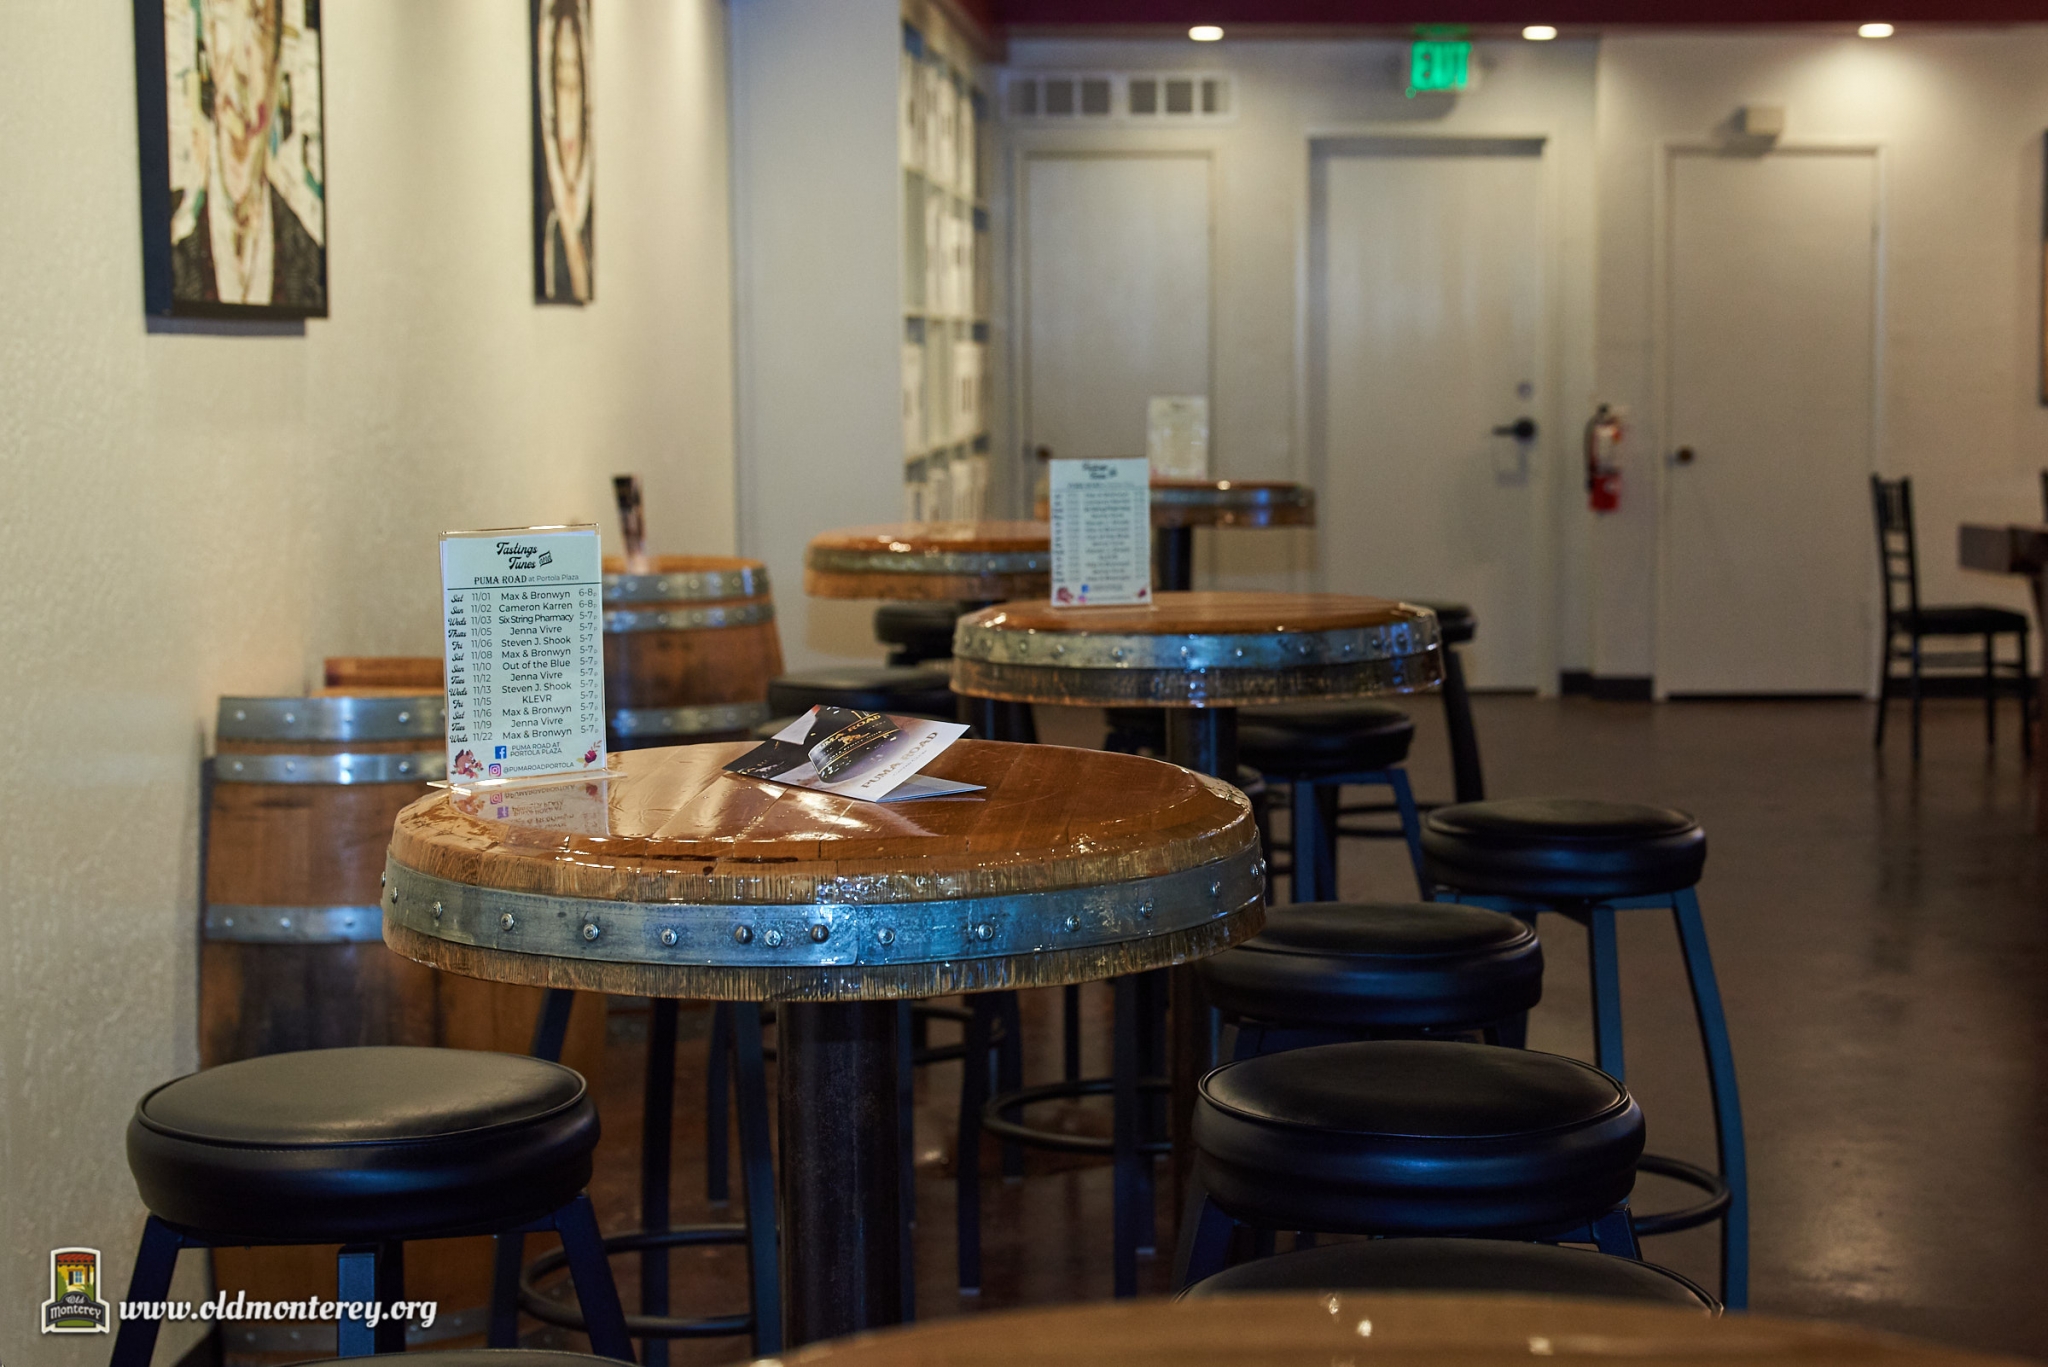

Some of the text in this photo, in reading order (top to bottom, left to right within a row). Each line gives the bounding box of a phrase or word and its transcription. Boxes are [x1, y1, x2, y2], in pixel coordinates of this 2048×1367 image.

[1411, 41, 1471, 90] EXIT
[496, 542, 538, 558] Tastings
[508, 556, 536, 570] Tunes
[474, 576, 500, 585] PUMA
[502, 575, 527, 584] ROAD
[536, 574, 560, 582] Portola
[561, 573, 580, 581] Plaza
[451, 594, 464, 603] Sat
[472, 592, 491, 602] 11/01
[501, 592, 522, 601] Max
[522, 592, 529, 600] &
[531, 590, 571, 600] Bronwyn
[450, 606, 464, 615] Sun
[471, 603, 492, 613] 11/02
[499, 603, 541, 613] Cameron
[543, 601, 573, 611] Karren
[448, 617, 467, 626] Weds
[471, 615, 492, 625] 11/03
[499, 616, 510, 624] Six
[510, 615, 533, 625] String
[534, 613, 574, 623] Pharmacy
[471, 627, 492, 637] 11/05
[510, 627, 538, 636] Jenna
[539, 625, 563, 634] Vivre
[451, 633, 593, 651] Fri 11/06 Steven J. Shook 5-7
[452, 653, 464, 662] Sat
[471, 650, 493, 660] 11/08
[501, 650, 521, 659] Max
[522, 650, 529, 658] &
[531, 648, 571, 658] Bronwyn
[451, 665, 465, 673] Sun
[472, 662, 492, 672] 11/10
[502, 661, 520, 671] Out
[522, 660, 532, 669] of
[533, 660, 548, 669] the
[550, 659, 571, 668] Blue
[451, 676, 465, 685] Tues
[473, 674, 491, 683] 11/12
[510, 673, 538, 682] Jenna
[539, 671, 563, 680] Vivre
[448, 687, 467, 696] Weds
[473, 685, 491, 695] 11/13
[501, 685, 533, 694] Steven
[534, 683, 542, 692] J.
[544, 682, 572, 691] Shook
[452, 699, 464, 709] Fri
[473, 697, 492, 707] 11/15
[522, 695, 553, 704] KLEVR
[452, 711, 465, 720] Sat
[473, 709, 492, 718] 11/16
[502, 708, 522, 717] Max
[523, 707, 530, 716] &
[531, 705, 572, 715] Bronwyn
[451, 722, 465, 731] Tues
[473, 720, 492, 730] 11/19
[511, 719, 538, 728] Jenna
[540, 717, 563, 726] Vivre
[449, 734, 468, 743] Weds
[472, 732, 493, 742] 11/22
[502, 731, 522, 740] Max
[523, 730, 530, 739] &
[532, 728, 573, 738] Bronwyn
[510, 749, 540, 757] PORTOLA
[503, 762, 575, 774] @PUMAROADPORTOLA
[861, 762, 901, 788] PUMA
